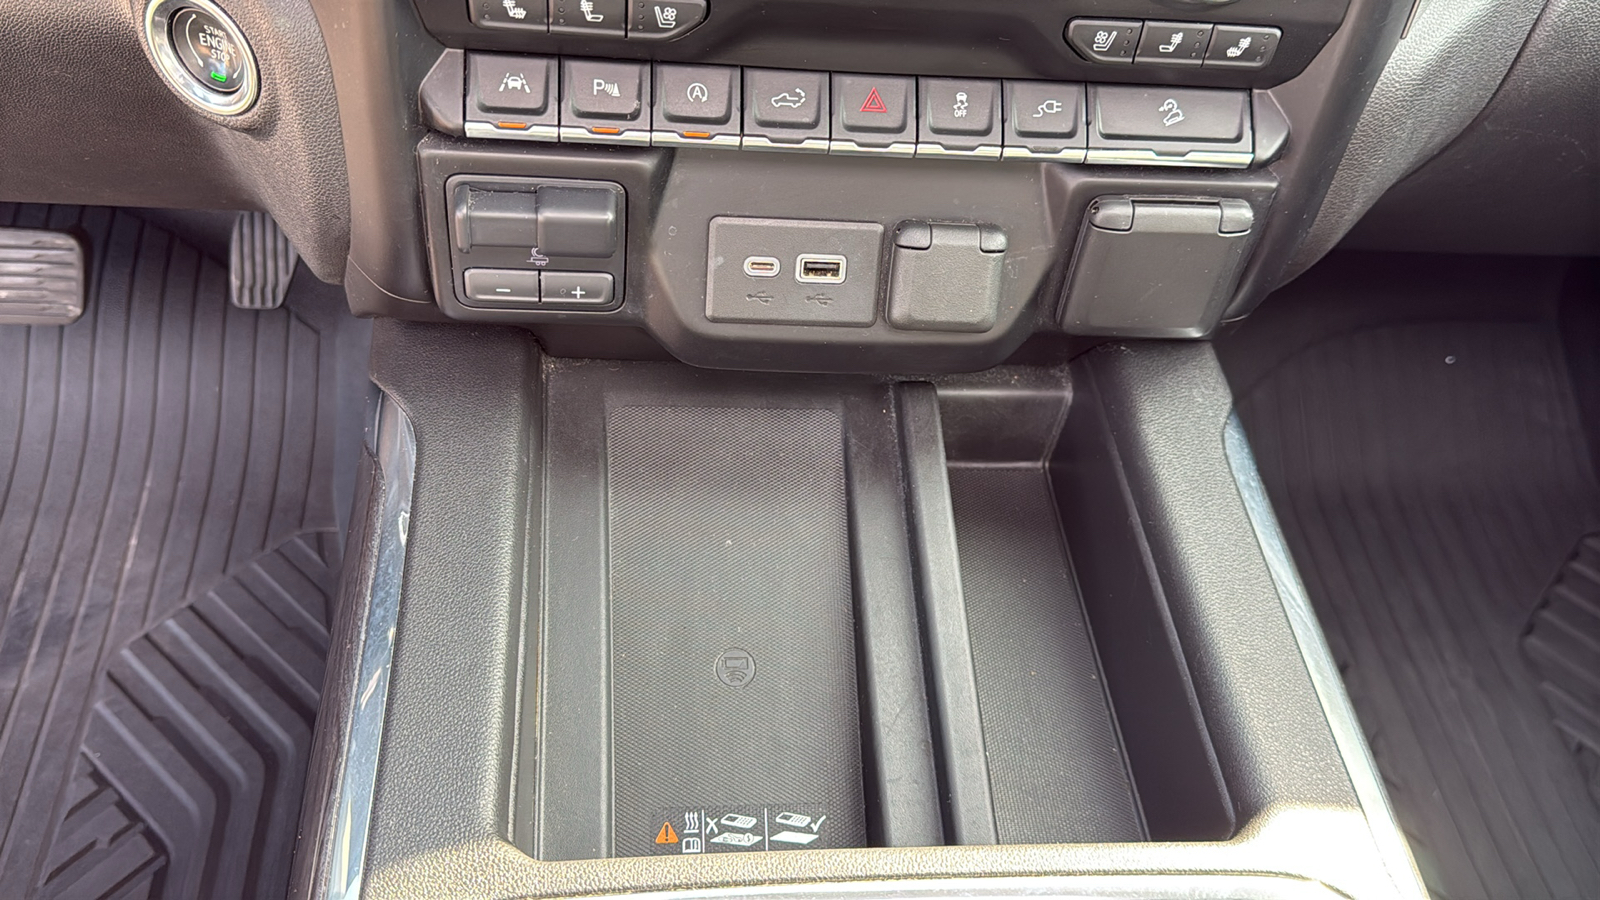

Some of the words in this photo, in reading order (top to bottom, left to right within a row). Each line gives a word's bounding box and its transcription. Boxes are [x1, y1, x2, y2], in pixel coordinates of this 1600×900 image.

[199, 33, 236, 57] ENGINE
[211, 49, 230, 61] STOP
[593, 79, 604, 95] P
[692, 84, 702, 98] A
[953, 109, 967, 118] OFF
